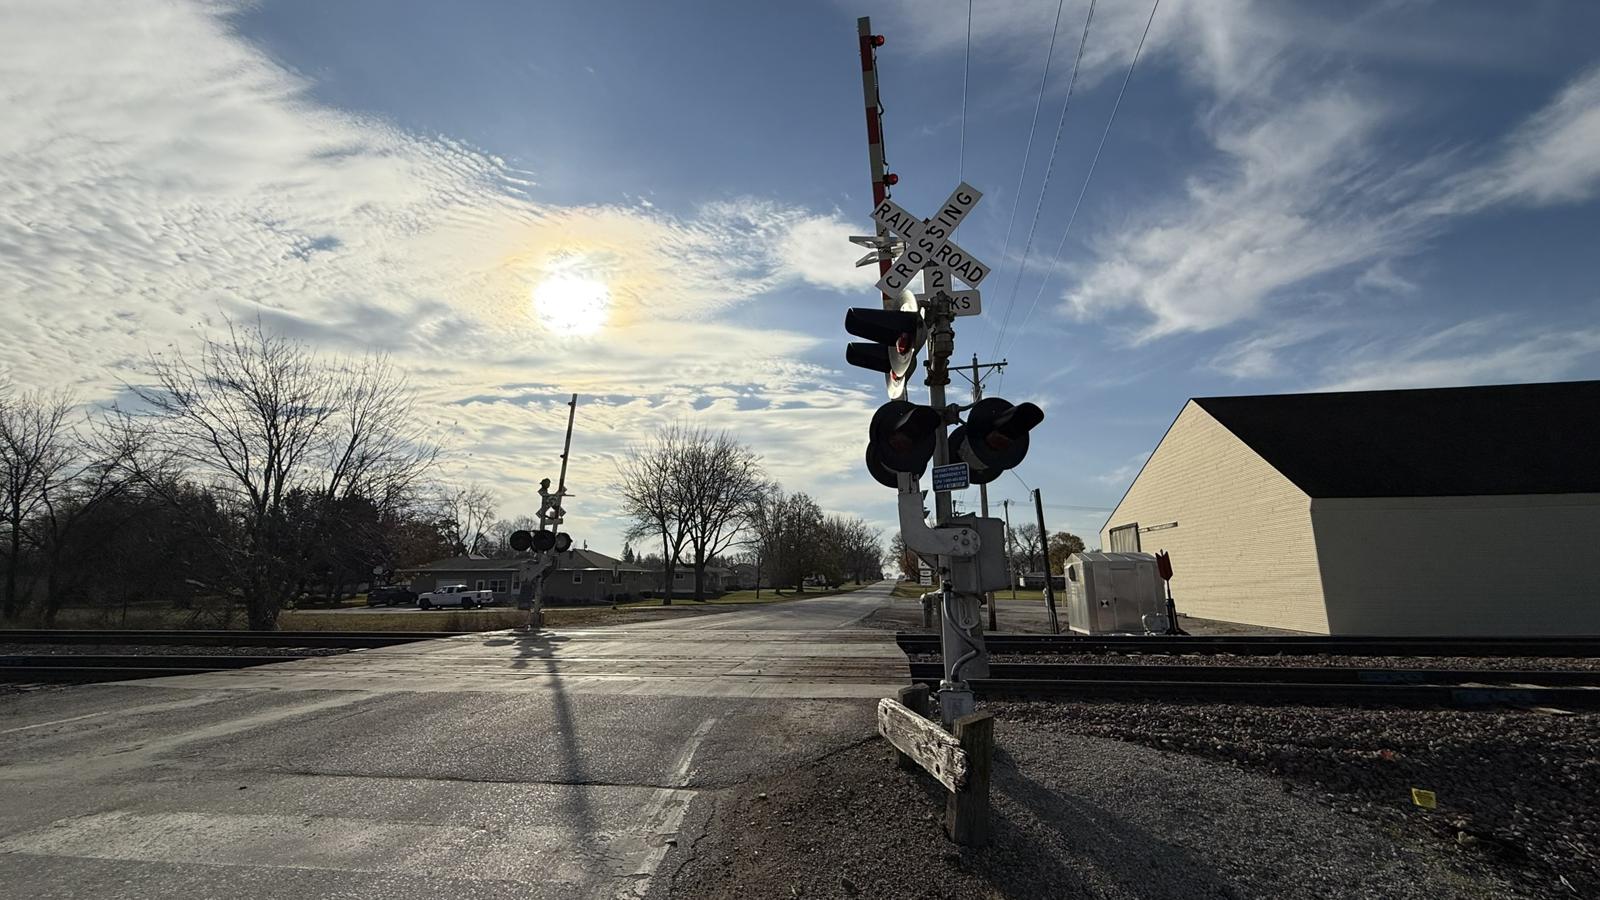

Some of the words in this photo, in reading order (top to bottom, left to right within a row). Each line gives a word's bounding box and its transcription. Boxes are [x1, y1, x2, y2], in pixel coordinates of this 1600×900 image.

[875, 203, 915, 238] RAIL
[936, 244, 983, 283] ROAD
[886, 192, 972, 289] CROSSING
[931, 270, 944, 287] 2
